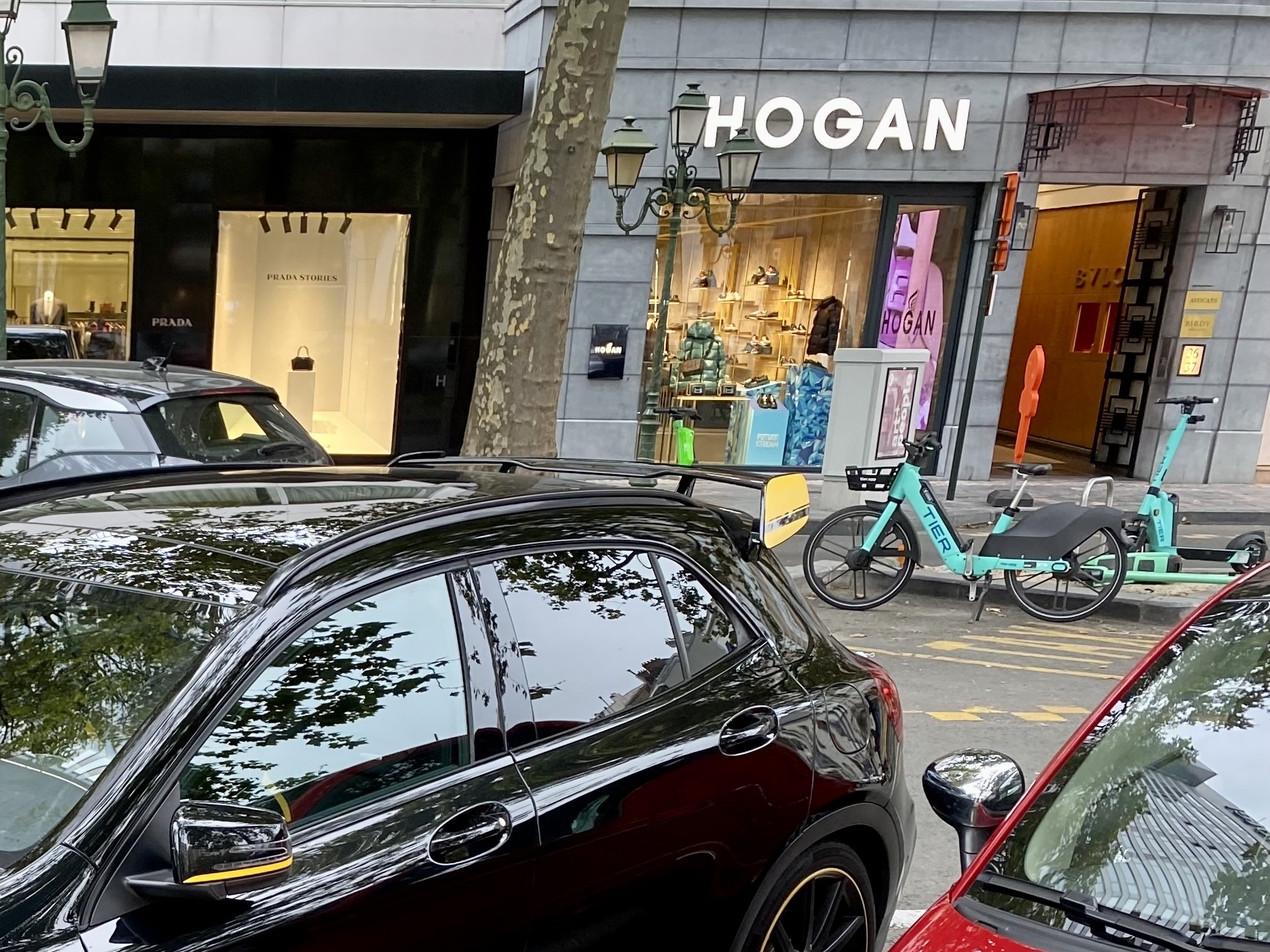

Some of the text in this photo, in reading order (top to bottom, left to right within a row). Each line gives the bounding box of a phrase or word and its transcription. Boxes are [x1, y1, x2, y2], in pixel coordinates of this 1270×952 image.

[703, 95, 971, 151] HOGAN
[267, 273, 338, 282] PRADA STORIES
[151, 318, 193, 327] PRADA
[881, 310, 937, 336] HOGAN
[923, 506, 952, 554] TIER
